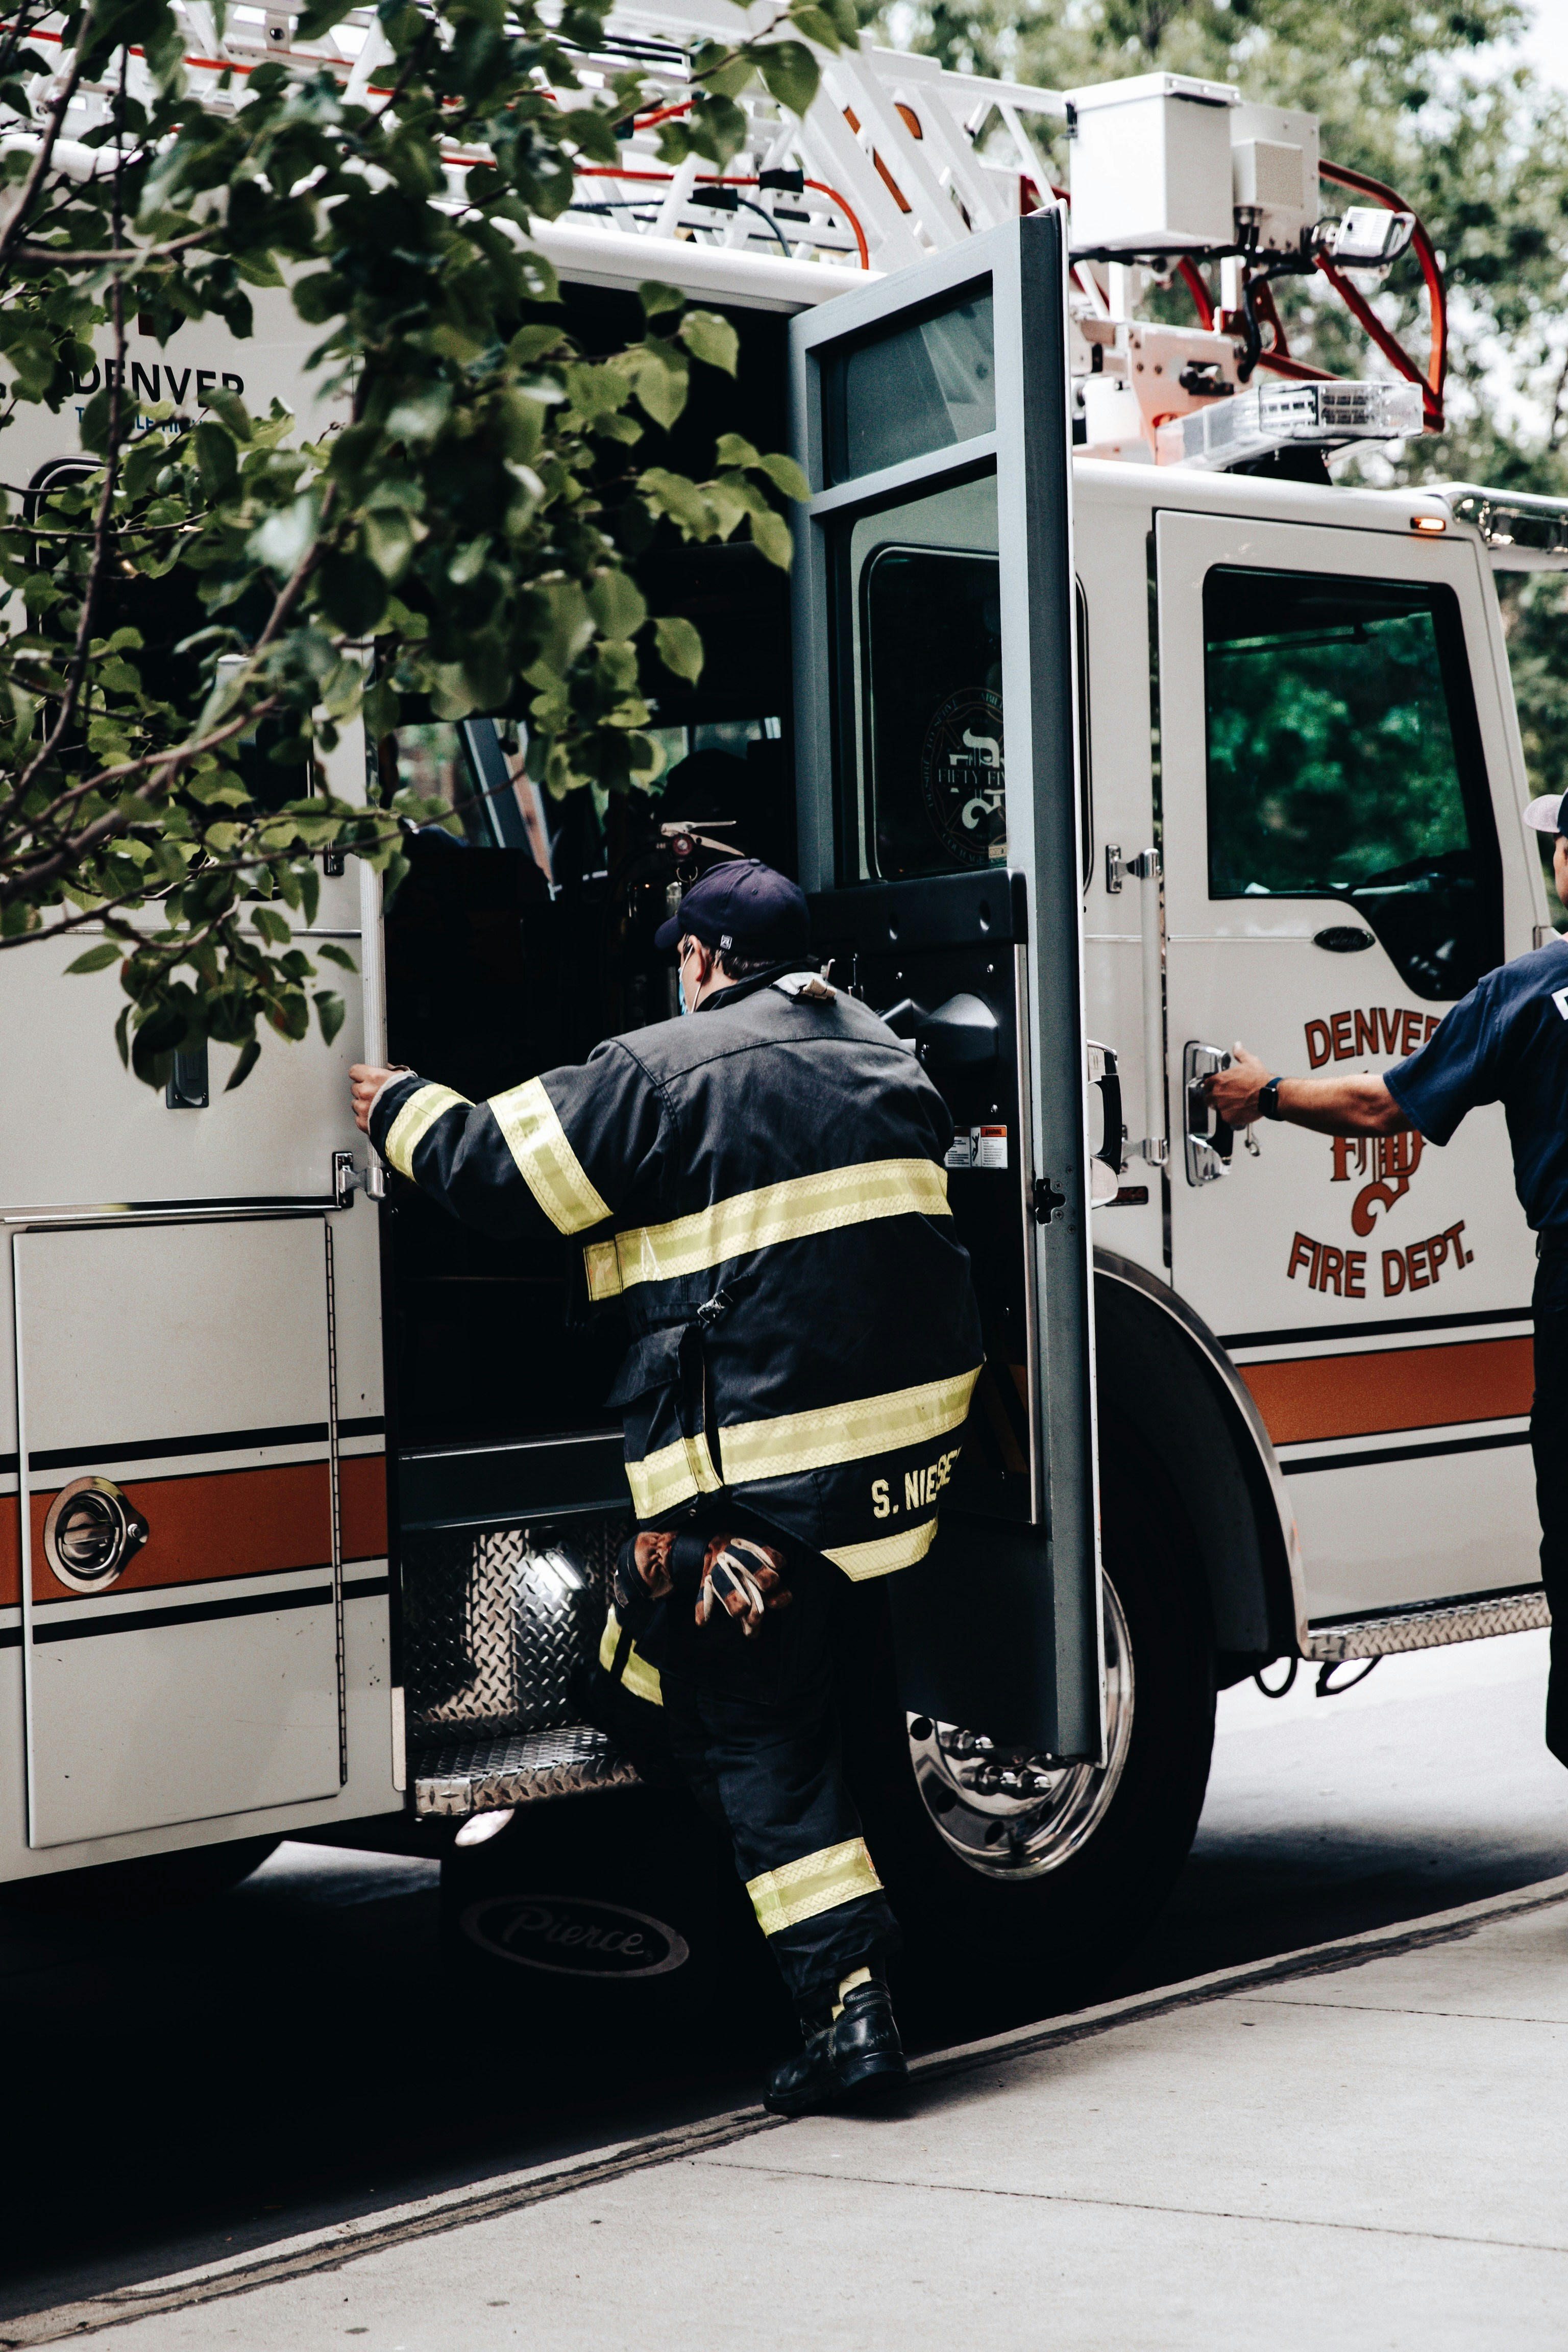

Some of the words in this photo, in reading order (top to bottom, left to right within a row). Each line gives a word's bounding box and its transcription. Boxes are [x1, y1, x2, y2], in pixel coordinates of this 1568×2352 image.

[74, 358, 243, 408] DENVER
[938, 768, 981, 785] FIFTY
[1287, 1231, 1367, 1298] FIRE
[1382, 1220, 1474, 1298] DEPT.
[871, 1479, 899, 1518] S.
[905, 1446, 963, 1510] NIESE
[502, 1905, 645, 1955] Pierce
